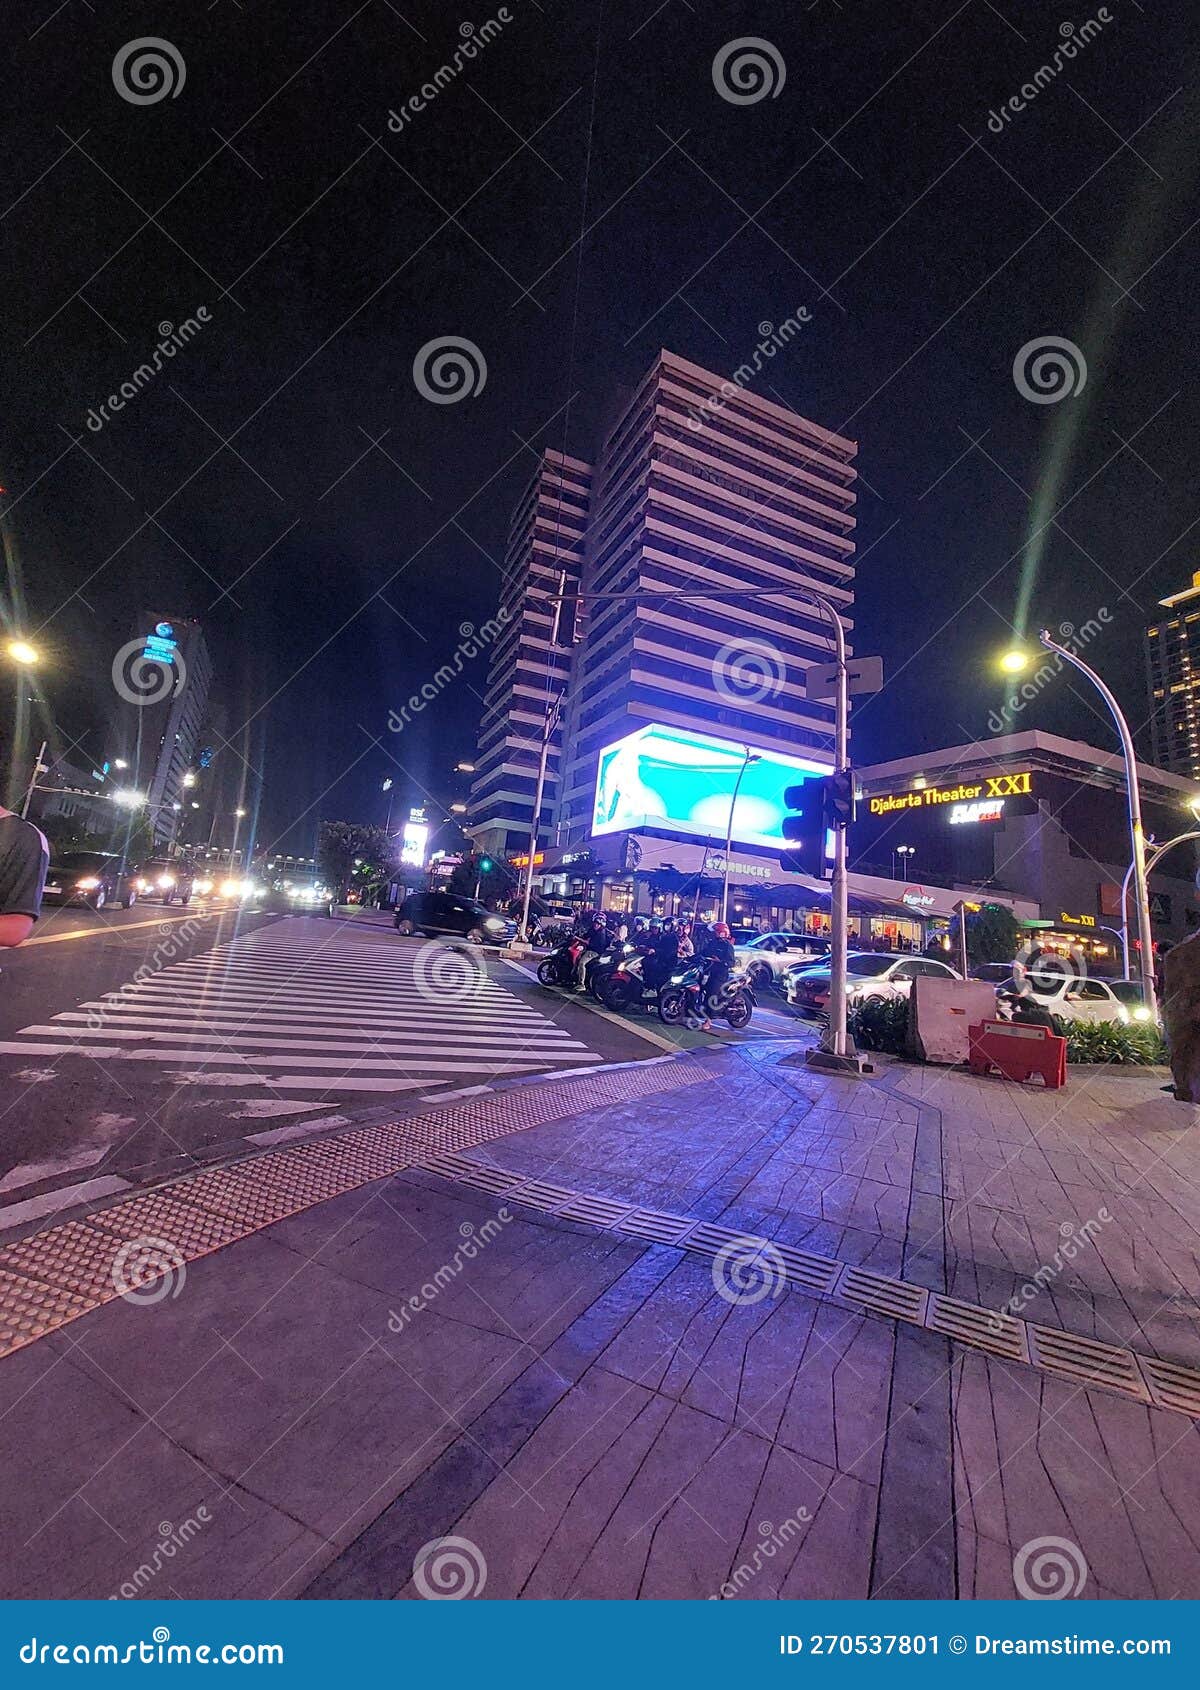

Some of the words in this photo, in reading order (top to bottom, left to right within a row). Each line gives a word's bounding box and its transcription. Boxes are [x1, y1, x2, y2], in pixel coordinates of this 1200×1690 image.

[870, 793, 922, 815] Djakarta
[922, 786, 982, 805] Theater
[985, 773, 1033, 798] XXI
[705, 858, 772, 877] STARBUCKS
